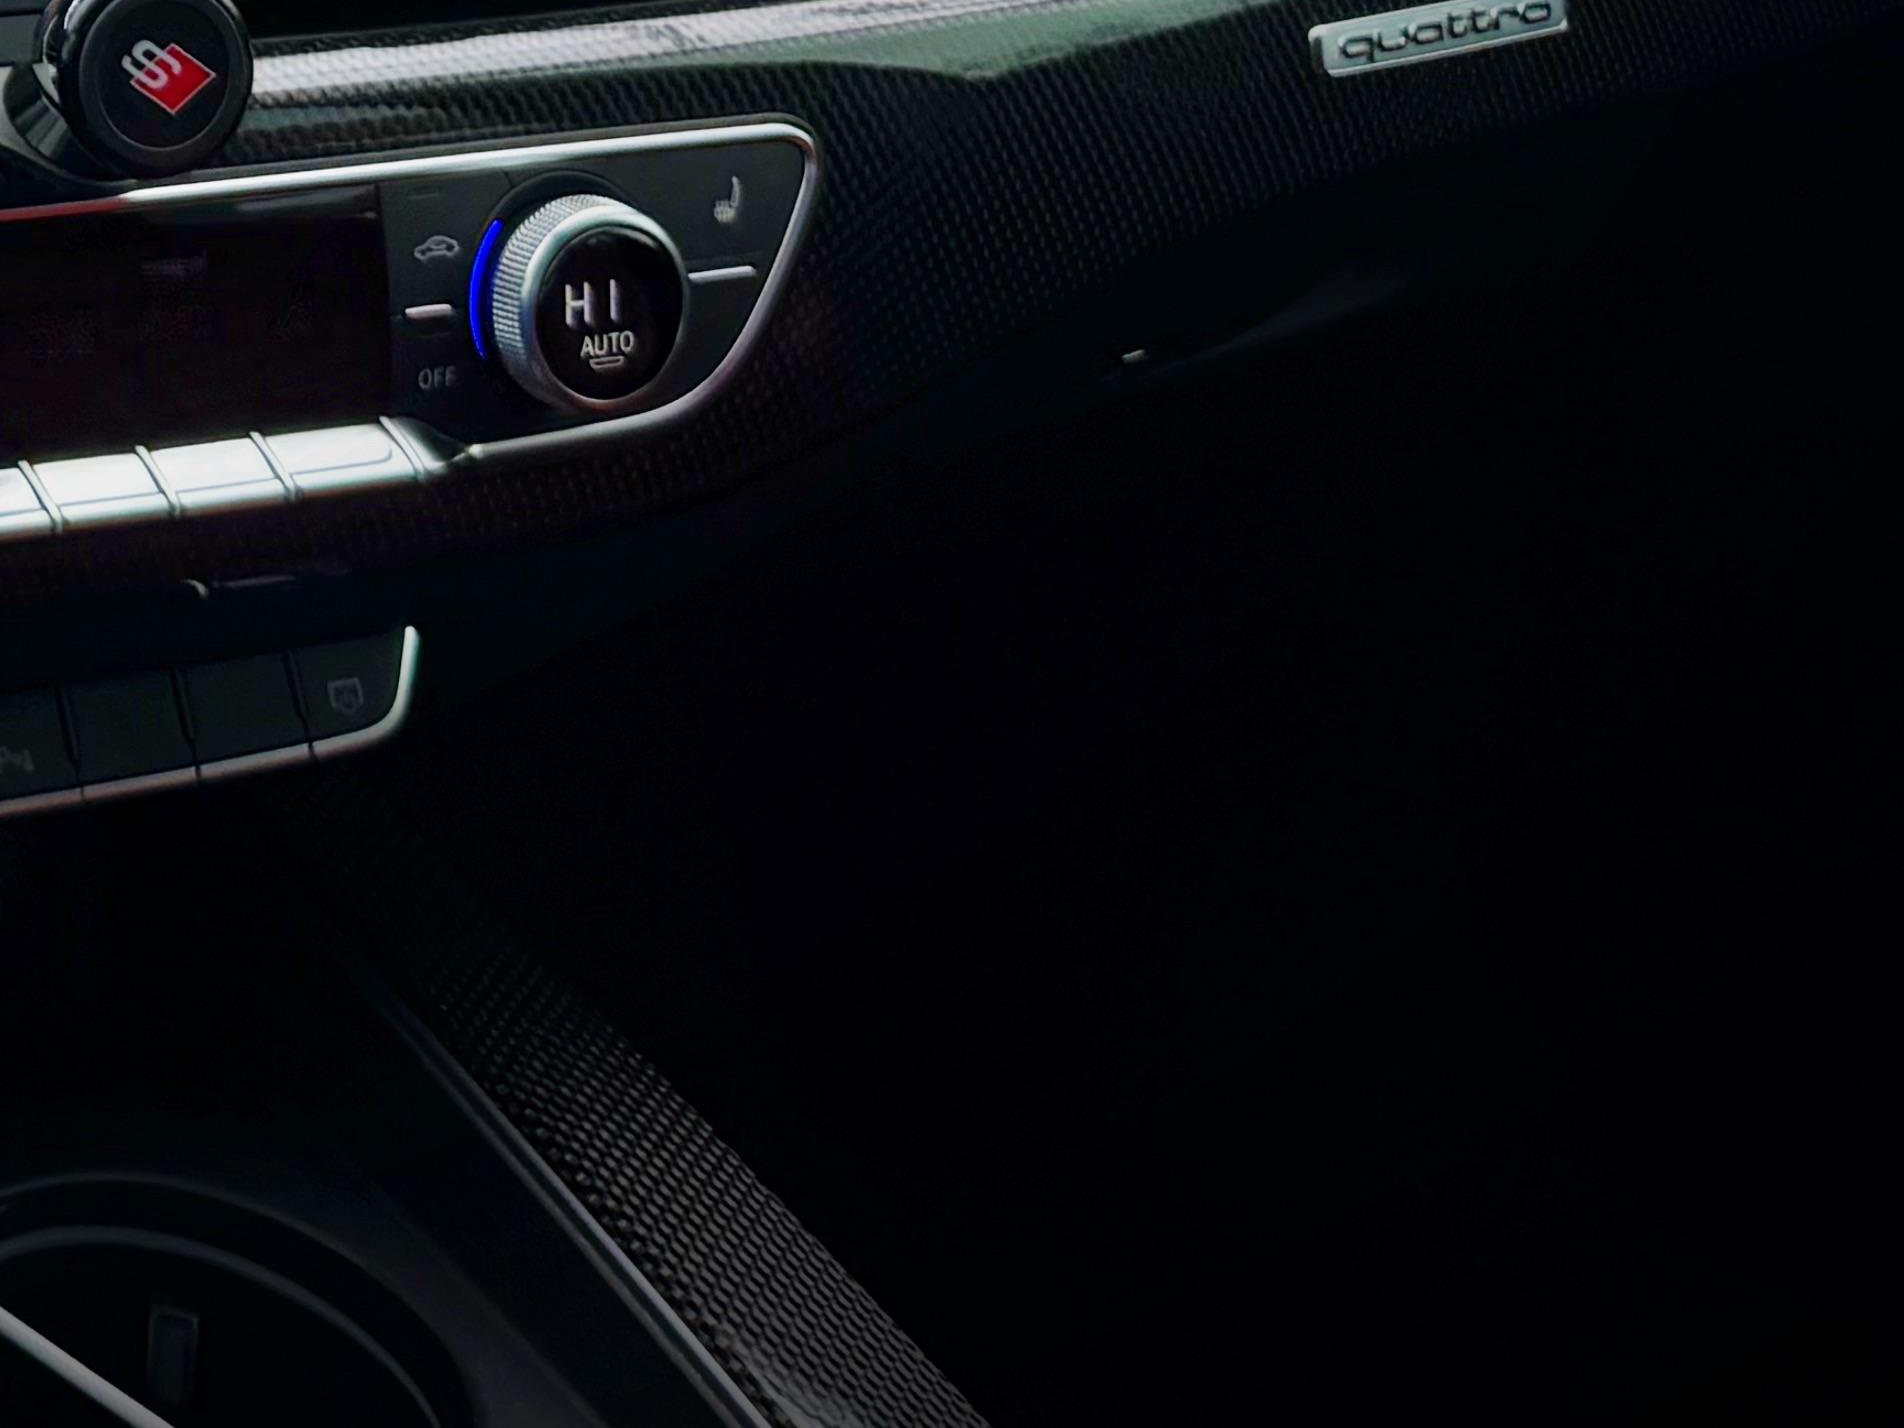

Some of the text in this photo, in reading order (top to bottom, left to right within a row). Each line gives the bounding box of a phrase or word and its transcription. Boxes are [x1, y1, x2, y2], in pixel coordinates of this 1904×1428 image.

[1339, 0, 1552, 63] quattro
[580, 330, 635, 359] AUTO
[418, 366, 457, 391] OFF
